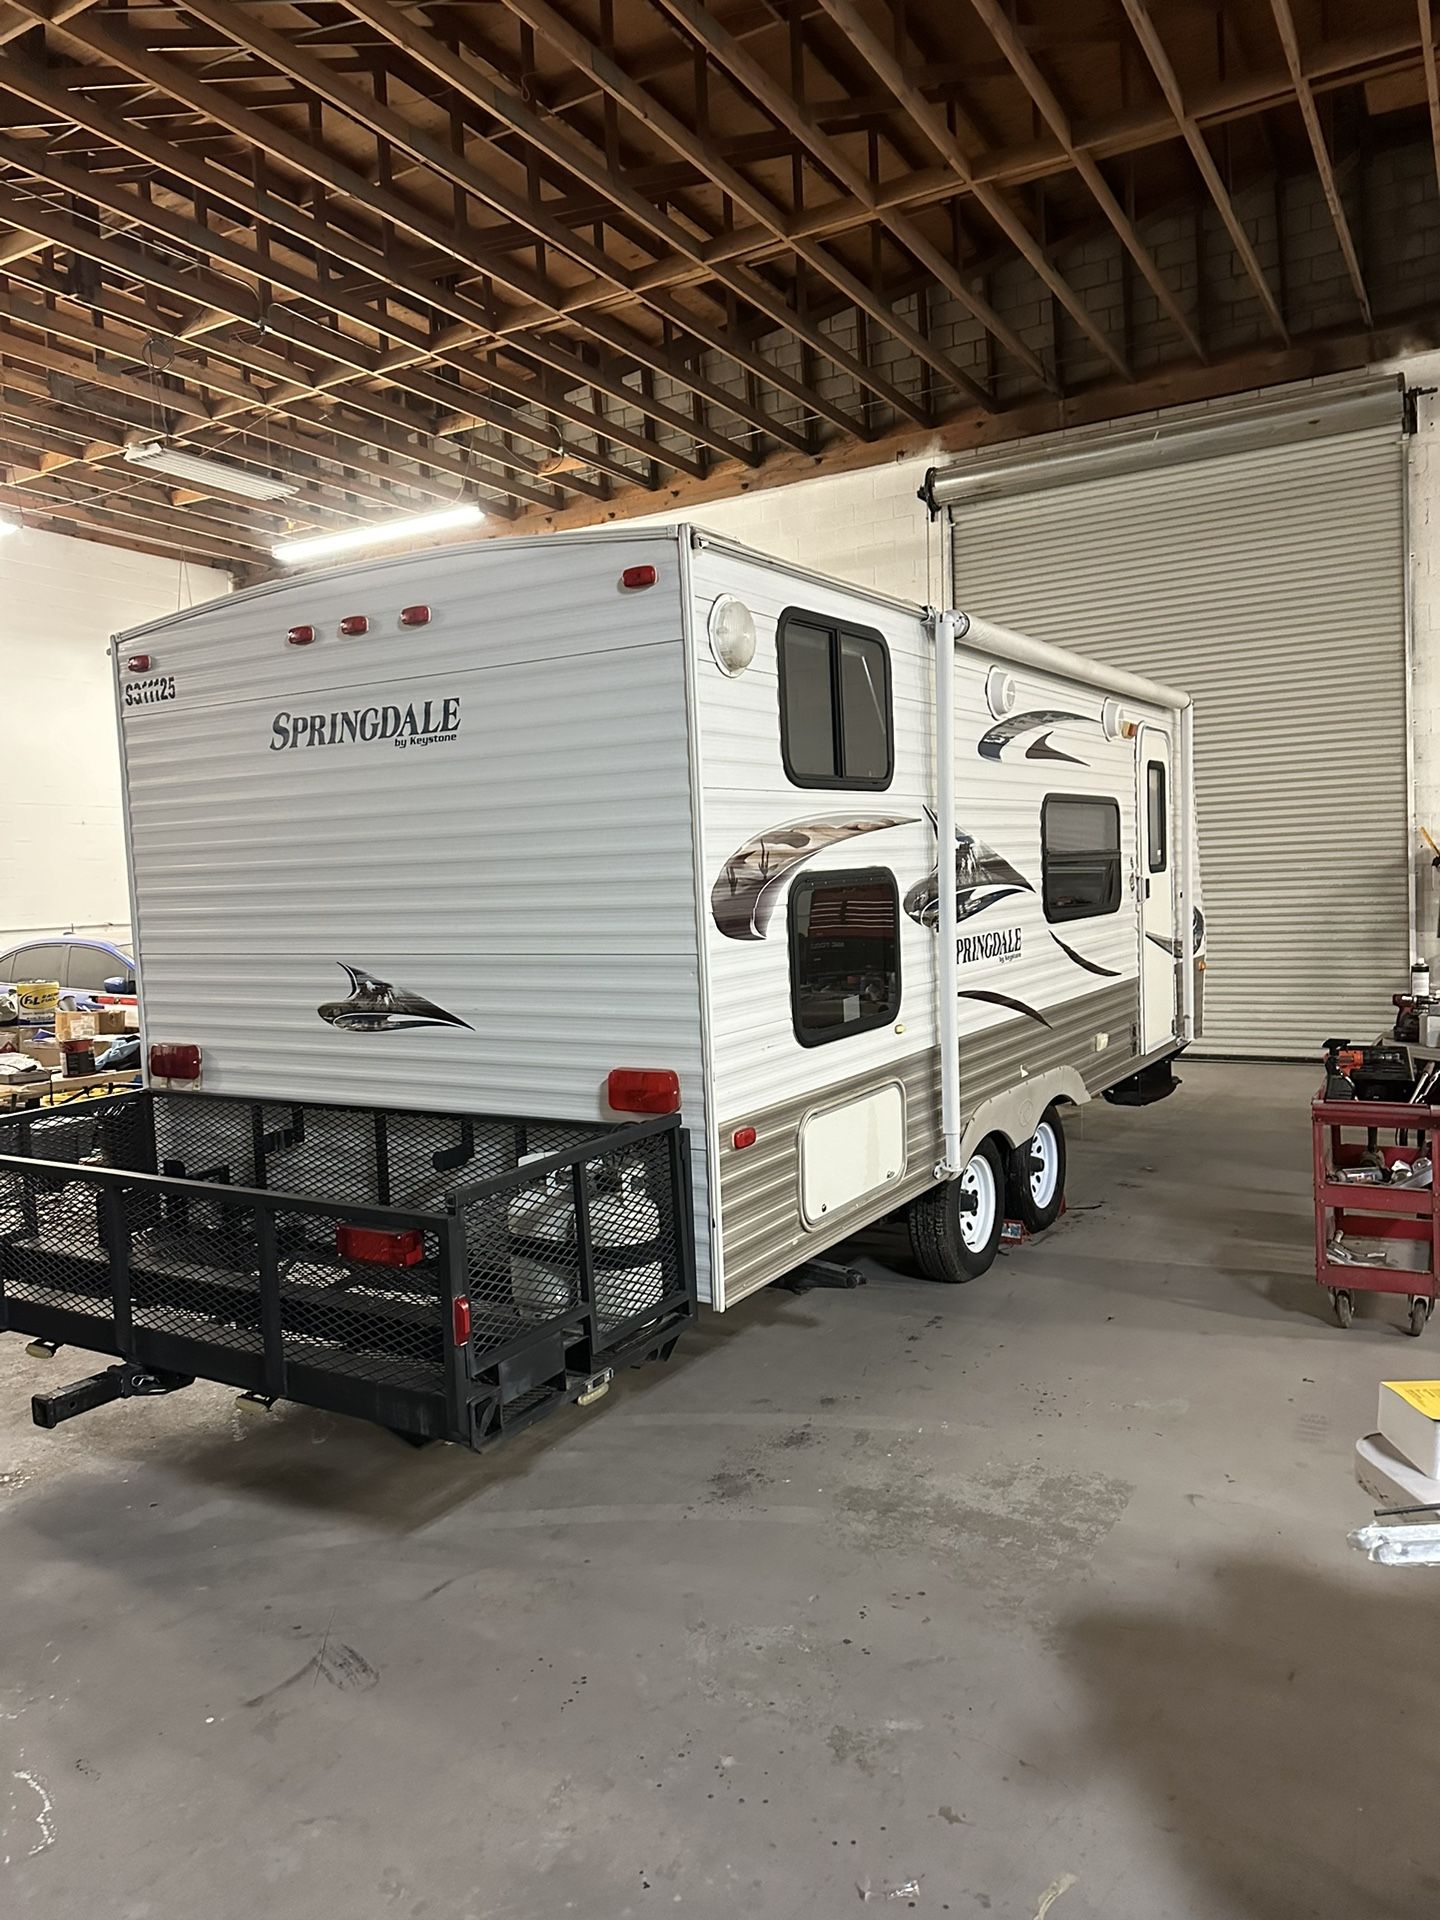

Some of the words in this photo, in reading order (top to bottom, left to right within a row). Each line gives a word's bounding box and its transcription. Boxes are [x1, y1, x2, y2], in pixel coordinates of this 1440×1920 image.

[270, 697, 462, 751] SPRINGDALE
[394, 737, 407, 749] by
[409, 732, 458, 747] Keystone
[956, 927, 1022, 965] PRINGDALE
